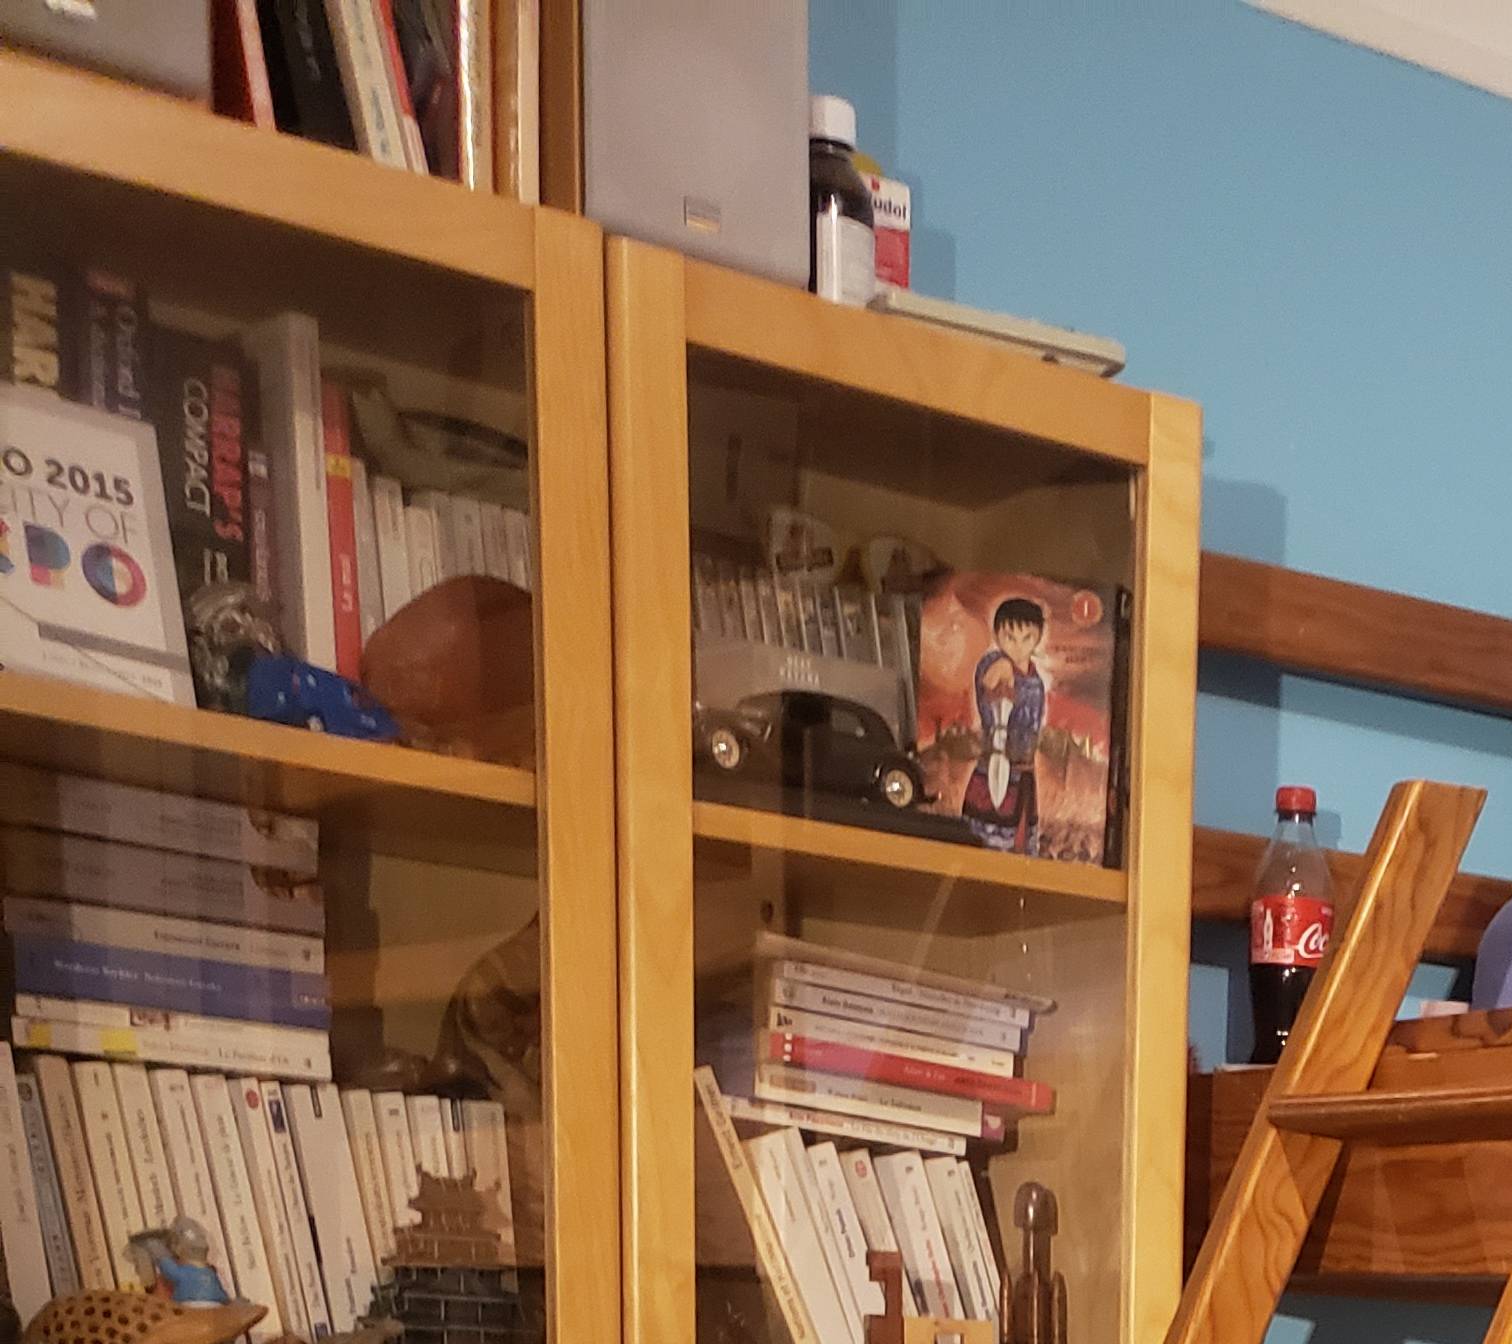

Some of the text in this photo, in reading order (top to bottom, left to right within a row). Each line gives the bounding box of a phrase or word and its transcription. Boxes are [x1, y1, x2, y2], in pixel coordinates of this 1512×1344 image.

[873, 198, 907, 220] udol
[183, 377, 210, 517] COMPACT
[45, 459, 134, 506] 2015
